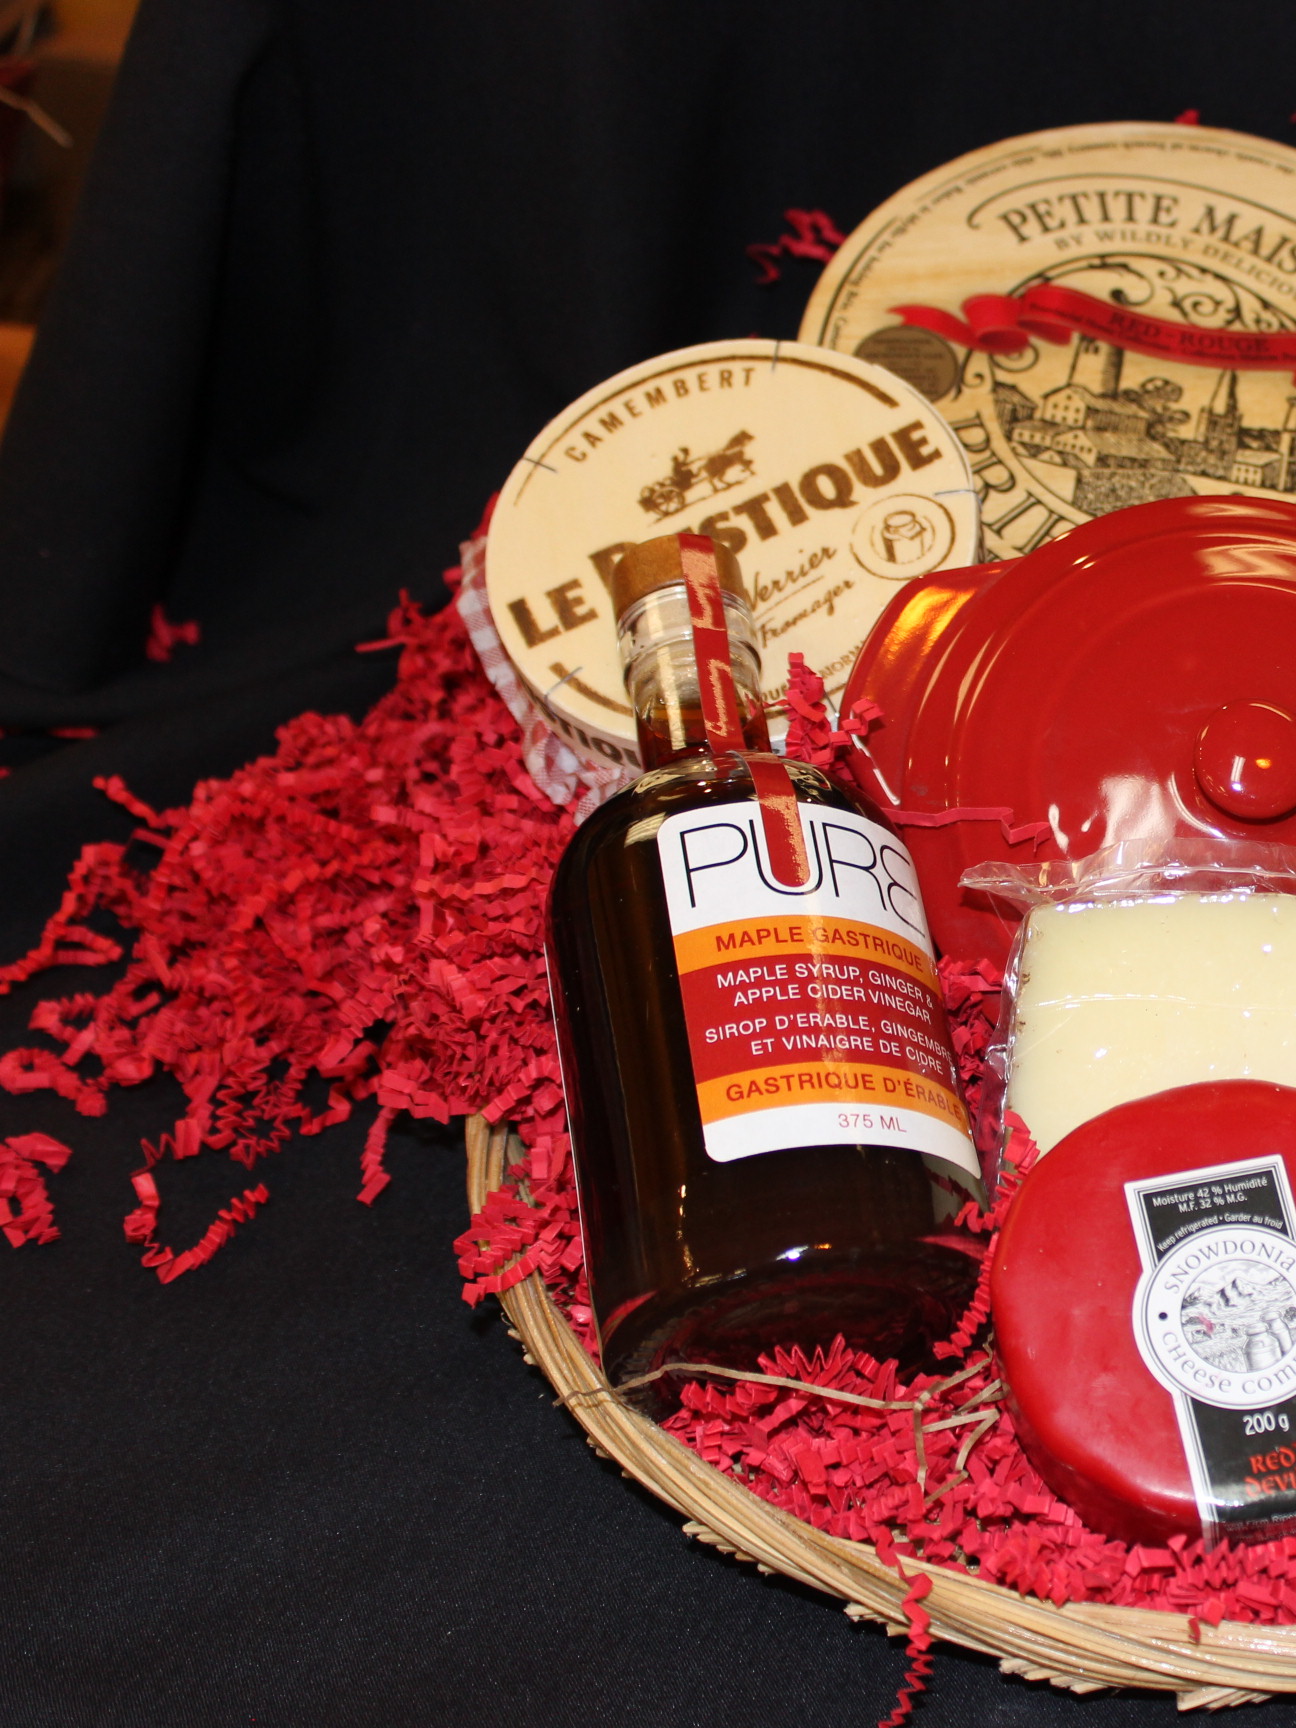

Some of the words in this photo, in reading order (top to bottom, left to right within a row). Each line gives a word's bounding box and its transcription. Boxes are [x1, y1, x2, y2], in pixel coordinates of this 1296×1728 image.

[998, 189, 1180, 246] PETITE
[1054, 230, 1084, 250] BY
[1094, 228, 1194, 251] WILDLY
[563, 366, 757, 465] CAMEMBERT
[507, 577, 600, 650] LE
[588, 419, 943, 590] STIQUE
[715, 926, 804, 953] MAPLE
[812, 925, 924, 974] GASTRIQUE
[716, 964, 789, 989] MAPLE
[794, 963, 864, 984] SYRUP,
[868, 970, 924, 1004] GINGER
[925, 994, 935, 1009] &
[733, 983, 802, 1007] APPLE
[806, 983, 867, 1003] CIDER
[868, 988, 932, 1026] VINEGAR
[704, 1017, 768, 1044] SIROP
[879, 1019, 954, 1064] GINGEMBRE
[750, 1038, 776, 1056] ET
[782, 1033, 875, 1052] VINAIGRE
[879, 1039, 903, 1058] DE
[904, 1045, 944, 1077] CIDRE
[725, 1071, 877, 1103] GASTRIQUE
[883, 1076, 963, 1122] D'ÉRABLE
[837, 1113, 875, 1130] 375
[880, 1114, 908, 1134] ML
[1152, 1187, 1195, 1209] Moisture
[1196, 1185, 1210, 1199] 42
[1211, 1184, 1223, 1197] %
[1224, 1176, 1269, 1196] Humidité
[1178, 1200, 1199, 1215] M.F.
[1199, 1199, 1213, 1211] 32
[1213, 1195, 1225, 1207] %
[1226, 1192, 1248, 1205] M.G.
[1156, 1235, 1177, 1254] Keep
[1174, 1215, 1219, 1241] refrigerated
[1223, 1212, 1252, 1224] Garder
[1252, 1215, 1264, 1225] au
[1264, 1215, 1284, 1231] froid
[1242, 1410, 1276, 1436] 200
[1278, 1413, 1290, 1433] g
[1248, 1445, 1296, 1475] RED
